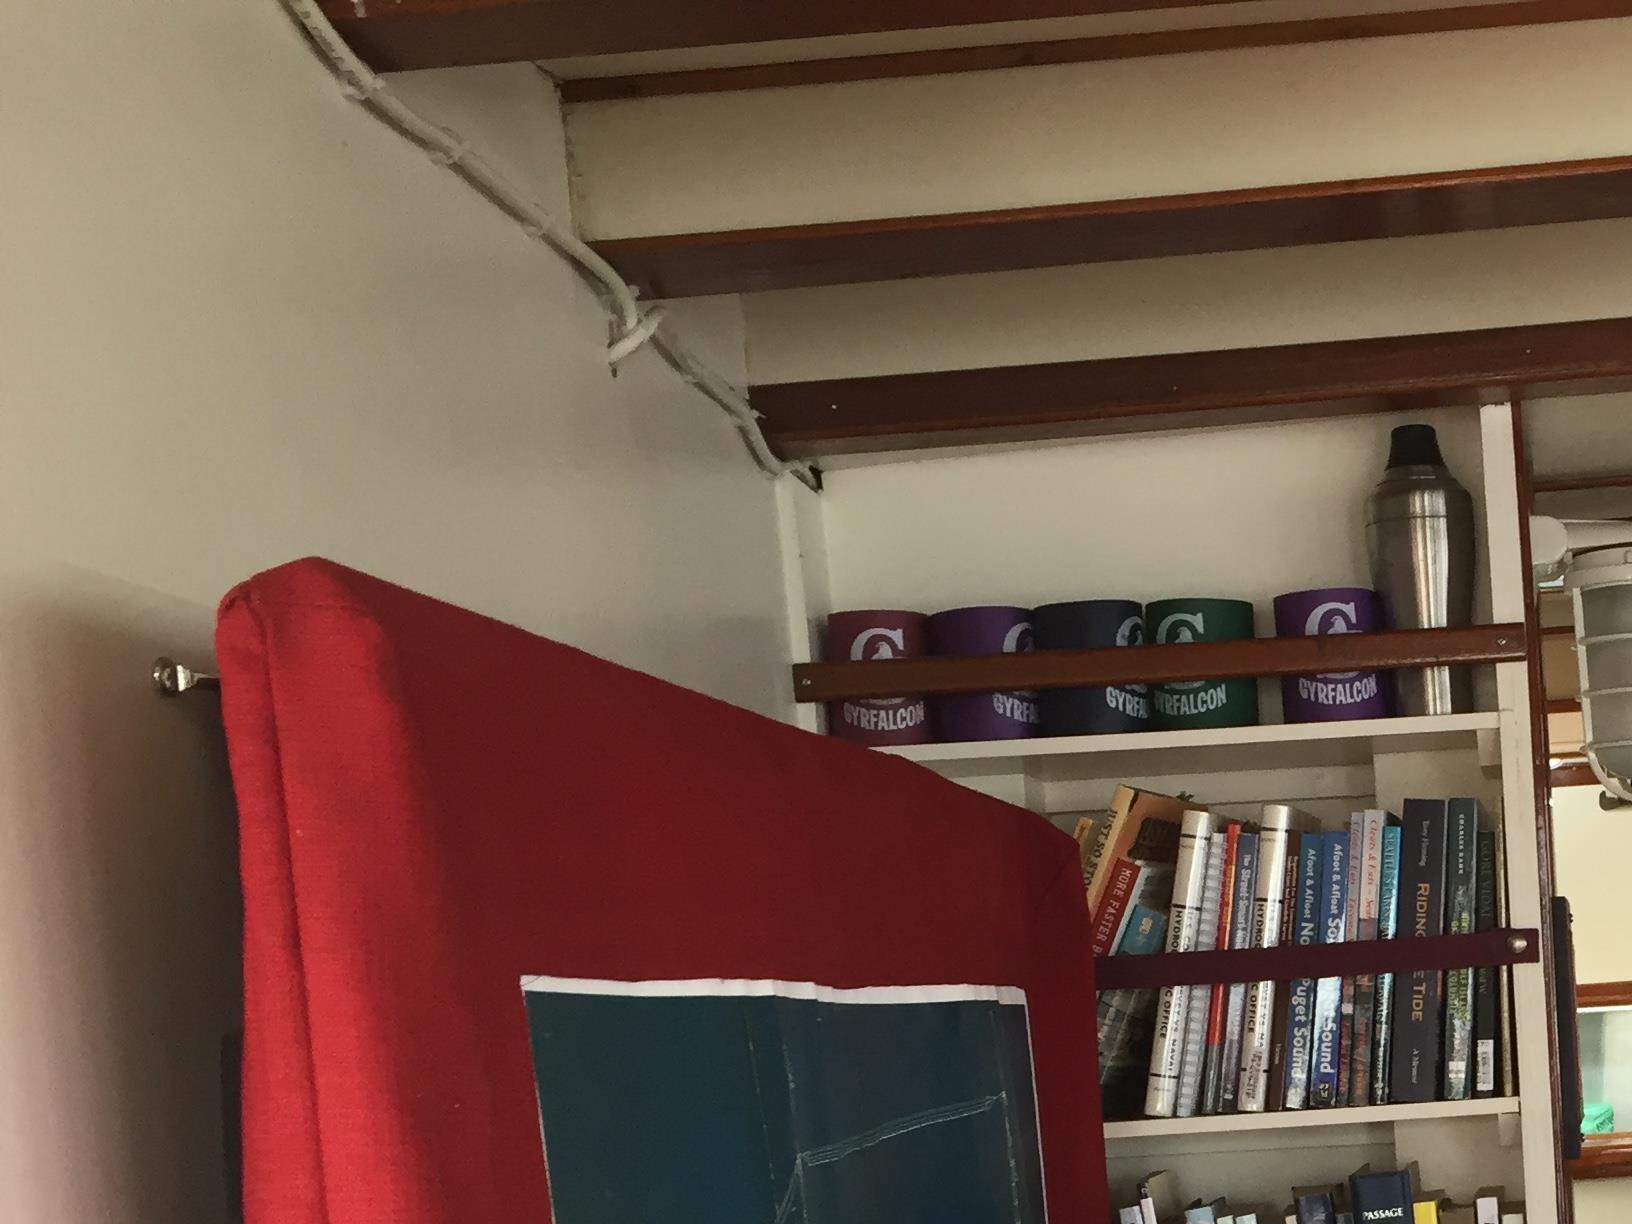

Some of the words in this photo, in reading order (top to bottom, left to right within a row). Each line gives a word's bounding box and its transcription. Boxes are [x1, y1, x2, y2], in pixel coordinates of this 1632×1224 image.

[1105, 685, 1148, 719] GYRFA
[1299, 673, 1377, 706] GYRFALCON
[843, 701, 925, 732] GYRFALCON
[992, 691, 1041, 735] GYRFA
[1306, 848, 1316, 876] Afoot
[1333, 843, 1344, 872] Afoot
[1113, 867, 1133, 897] MORE
[1304, 889, 1314, 918] Afloat
[1330, 884, 1341, 914] Afloat
[1097, 899, 1120, 942] FASTER
[1170, 910, 1183, 953] HYDRO
[1300, 922, 1315, 945] No
[1247, 993, 1258, 1033] OFFICE
[1410, 982, 1428, 1022] TIDE
[1159, 1001, 1173, 1039] OFFICE
[1292, 1027, 1309, 1078] Sound
[1361, 1207, 1405, 1221] PASSAGE
